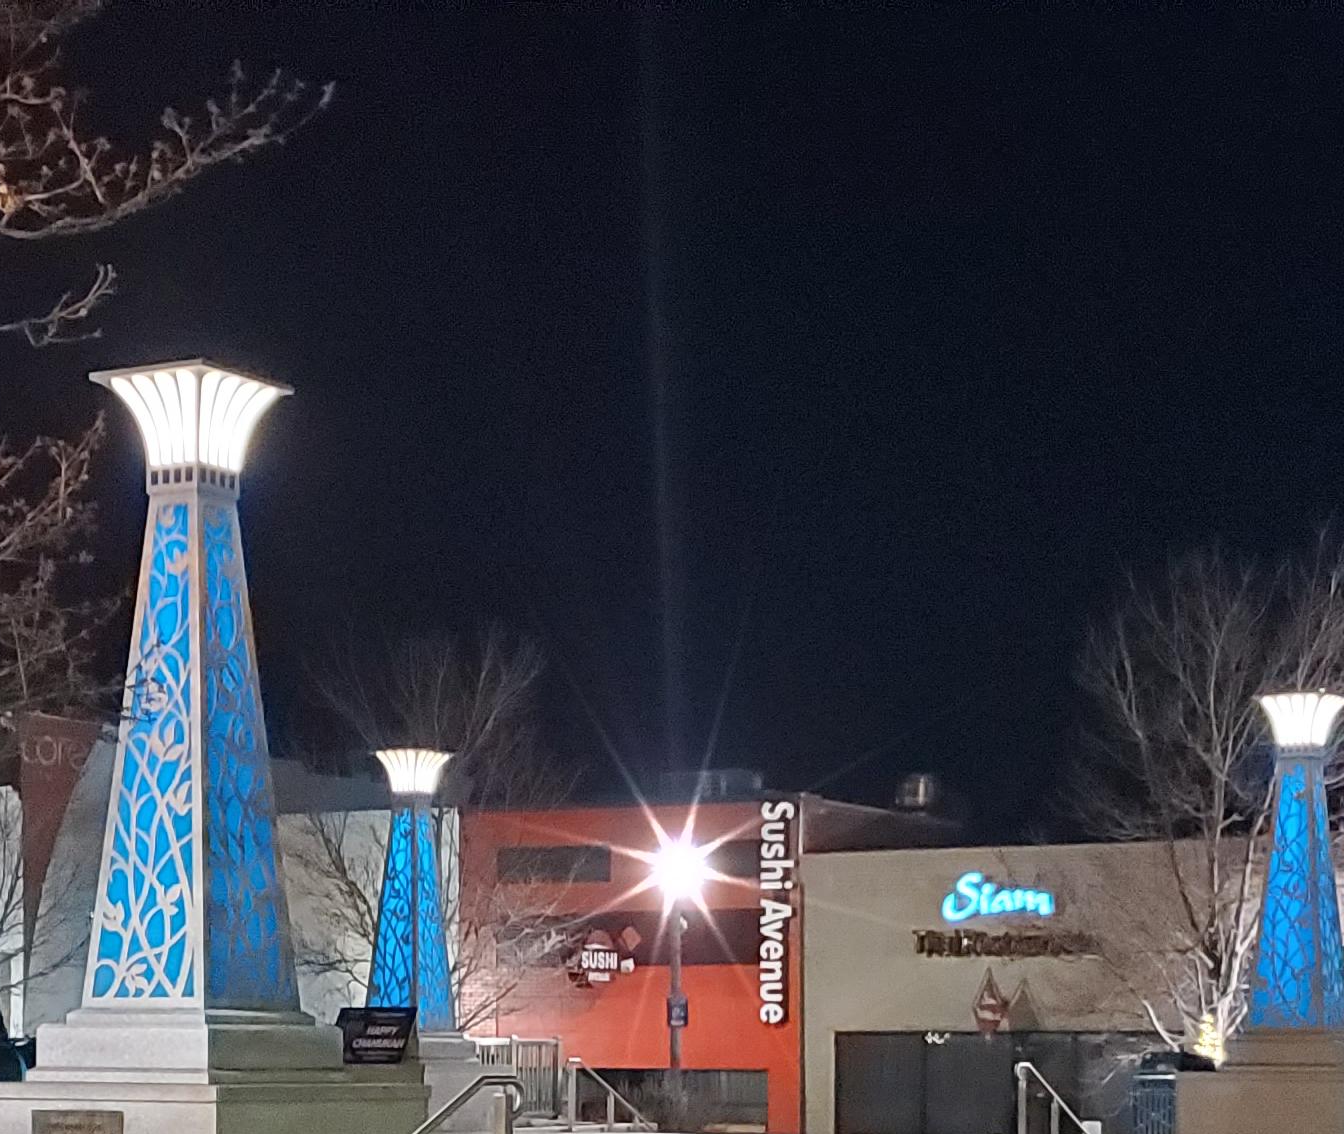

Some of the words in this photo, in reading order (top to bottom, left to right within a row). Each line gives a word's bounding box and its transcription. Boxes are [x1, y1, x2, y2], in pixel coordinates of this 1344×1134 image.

[760, 801, 795, 890] Sushi
[941, 870, 1055, 923] Siam
[581, 951, 618, 970] SUSHI
[759, 898, 793, 1024] Avenue
